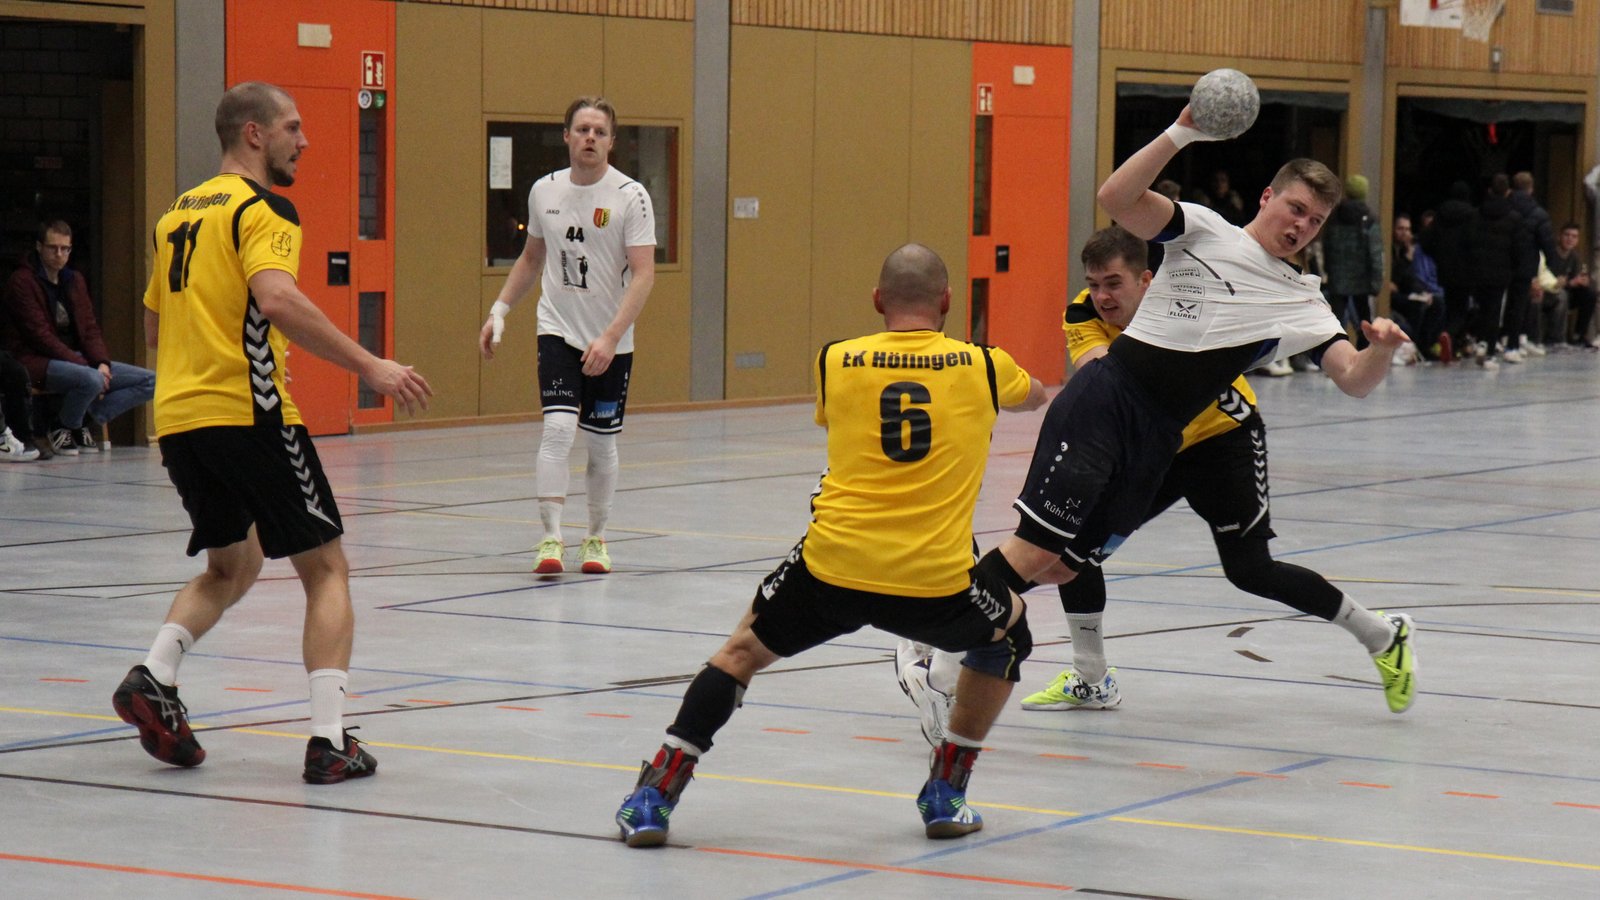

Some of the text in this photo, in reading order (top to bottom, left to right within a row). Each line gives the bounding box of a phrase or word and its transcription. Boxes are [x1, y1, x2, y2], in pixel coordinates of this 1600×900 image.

[565, 226, 585, 242] 44
[167, 217, 203, 293] 11
[1169, 311, 1197, 320] FLURER
[872, 351, 973, 371] Höfingen
[879, 381, 932, 463] 6
